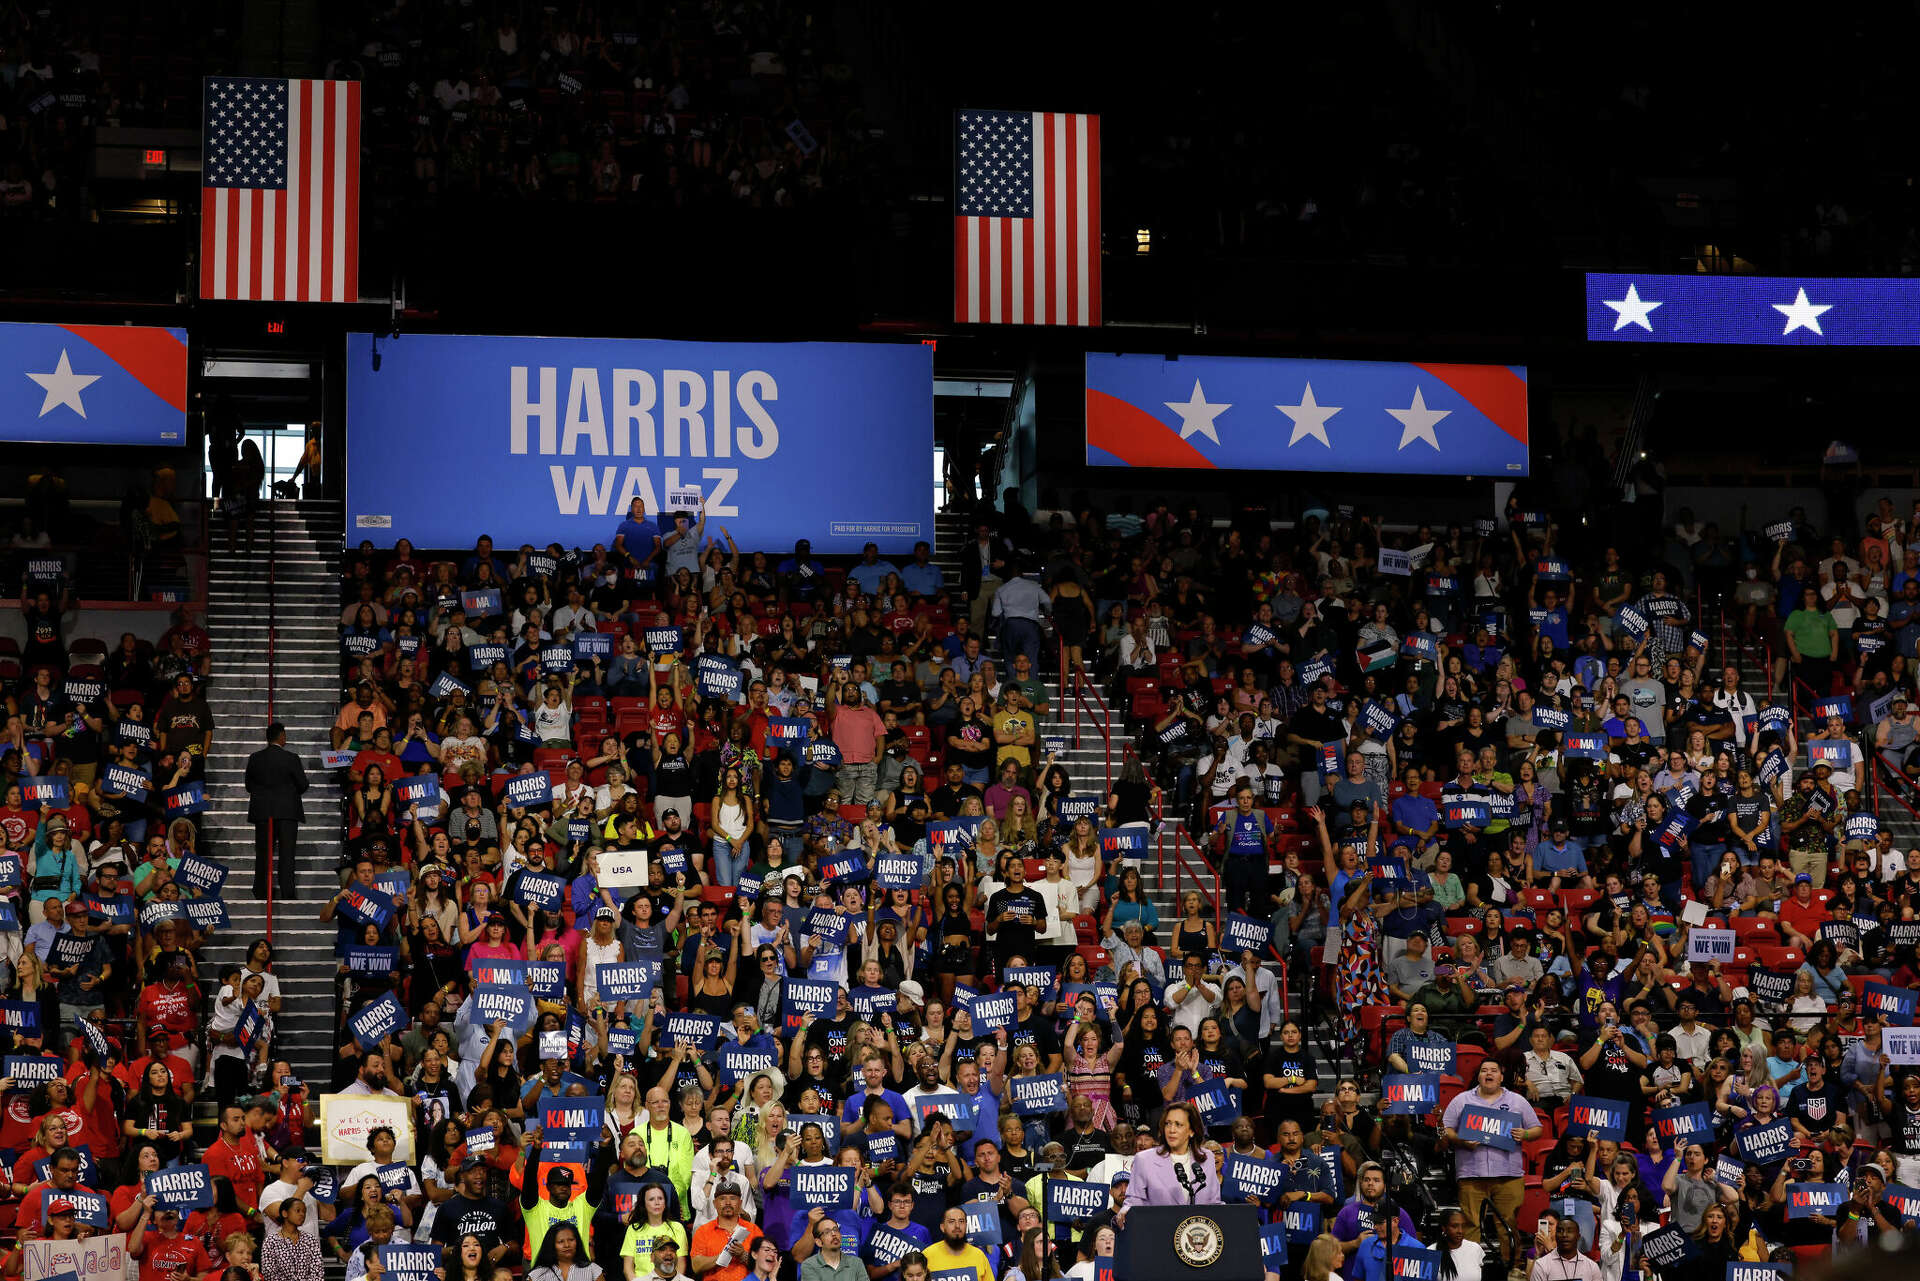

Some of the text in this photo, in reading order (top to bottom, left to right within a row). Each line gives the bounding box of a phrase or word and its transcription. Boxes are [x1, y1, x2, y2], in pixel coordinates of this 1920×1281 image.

[146, 150, 164, 163] EXIT
[510, 366, 779, 459] HARRIS
[670, 495, 699, 506] WE WIN
[1766, 521, 1792, 536] HARRIS
[29, 560, 62, 573] HARRIS
[531, 556, 556, 570] HARRIS
[1383, 557, 1408, 568] WE WIN
[535, 567, 553, 576] WALZ
[1649, 601, 1678, 612] HARRIS
[1656, 608, 1675, 616] WALZ
[1620, 607, 1648, 632] HARRIS
[345, 636, 377, 649] HARRIS
[647, 631, 678, 645] HARRIS
[350, 645, 370, 653] WALZ
[474, 647, 504, 659] HARRIS
[578, 642, 610, 653] WE WIN
[651, 643, 673, 651] WALZ
[542, 649, 571, 662] HARRIS
[546, 660, 568, 668] WALZ
[704, 672, 738, 688] HARRIS
[65, 682, 100, 695] HARRIS
[69, 694, 93, 702] WALZ
[1366, 704, 1395, 725] HARRIS
[1536, 706, 1569, 723] HARRIS
[1816, 703, 1849, 717] KAMALA
[1542, 717, 1564, 727] WALZ
[120, 722, 150, 739] HARRIS
[771, 724, 810, 739] KAMALA
[1568, 739, 1603, 750] KAMALA
[1812, 748, 1848, 760] KAMALA
[108, 769, 145, 787] HARRIS
[24, 785, 65, 800] KAMALA
[113, 782, 137, 794] WALZ
[397, 785, 435, 800] KAMALA
[508, 776, 546, 796] HARRIS
[168, 790, 205, 809] KAMALA
[515, 791, 542, 801] WALZ
[1062, 802, 1094, 813] HARRIS
[1449, 808, 1486, 820] KAMALA
[569, 824, 589, 834] HARRIS
[1846, 819, 1877, 830] HARRIS
[1104, 837, 1142, 850] KAMALA
[662, 853, 685, 866] HARRIS
[183, 858, 222, 881] HARRIS
[612, 866, 632, 875] USA
[822, 857, 862, 879] KAMALA
[878, 861, 917, 874] HARRIS
[187, 873, 212, 888] WALZ
[740, 877, 760, 888] HARRIS
[884, 874, 910, 884] WALZ
[520, 880, 558, 897] HARRIS
[524, 893, 549, 905] WALZ
[89, 900, 131, 917] KAMALA
[187, 902, 223, 921] HARRIS
[196, 916, 219, 925] WALZ
[810, 912, 846, 932] HARRIS
[1230, 921, 1269, 941] HARRIS
[56, 939, 93, 955] HARRIS
[1236, 937, 1260, 951] WALZ
[1694, 941, 1730, 953] WE WIN
[350, 958, 391, 970] WE WIN
[479, 968, 523, 985] KAMALA
[602, 968, 648, 986] HARRIS
[1009, 973, 1050, 987] HARRIS
[1752, 975, 1791, 991] HARRIS
[611, 985, 641, 994] WALZ
[788, 985, 833, 1002] HARRIS
[1757, 988, 1782, 998] WALZ
[478, 993, 524, 1013] HARRIS
[871, 993, 895, 1002] HARRIS
[1867, 991, 1909, 1012] KAMALA
[795, 1001, 824, 1012] WALZ
[975, 998, 1013, 1020] HARRIS
[354, 1000, 396, 1036] HARRIS
[484, 1009, 514, 1022] WALZ
[985, 1016, 1010, 1027] WALZ
[368, 1017, 396, 1039] WALZ
[667, 1018, 713, 1036] HARRIS
[609, 1033, 634, 1043] HARRIS
[674, 1034, 702, 1043] WALZ
[828, 1037, 847, 1046] ONE
[1014, 1036, 1035, 1046] ONE
[1411, 1046, 1451, 1061] HARRIS
[1889, 1041, 1904, 1054] WE
[726, 1053, 772, 1069] HARRIS
[1144, 1053, 1162, 1063] ONE
[1418, 1060, 1445, 1070] WALZ
[11, 1062, 57, 1079] HARRIS
[1283, 1068, 1304, 1077] ONE
[1016, 1080, 1058, 1099] HARRIS
[1388, 1085, 1436, 1102] KAMALA
[1025, 1097, 1053, 1108] WALZ
[1808, 1098, 1825, 1106] USA
[547, 1110, 599, 1128] KAMALA
[1466, 1114, 1513, 1136] KAMALA
[1574, 1107, 1621, 1129] KAMALA
[1658, 1115, 1708, 1136] KAMALA
[467, 1131, 494, 1144] HARRIS
[869, 1137, 895, 1148] HARRIS
[1743, 1126, 1789, 1151] HARRIS
[874, 1145, 892, 1153] WALZ
[1754, 1144, 1785, 1159] WALZ
[1233, 1162, 1281, 1186] HARRIS
[1717, 1160, 1743, 1176] HARRIS
[151, 1171, 204, 1191] HARRIS
[798, 1174, 848, 1191] HARRIS
[163, 1190, 198, 1202] WALZ
[1238, 1182, 1270, 1196] WALZ
[806, 1194, 839, 1203] WALZ
[1054, 1187, 1101, 1206] HARRIS
[1792, 1191, 1842, 1206] KAMALA
[1061, 1205, 1093, 1217] WALZ
[457, 1220, 496, 1234] Union
[1643, 1230, 1684, 1257] HARRIS
[387, 1252, 435, 1270] HARRIS
[1656, 1248, 1686, 1266] WALZ
[1392, 1256, 1433, 1277] KAMALA
